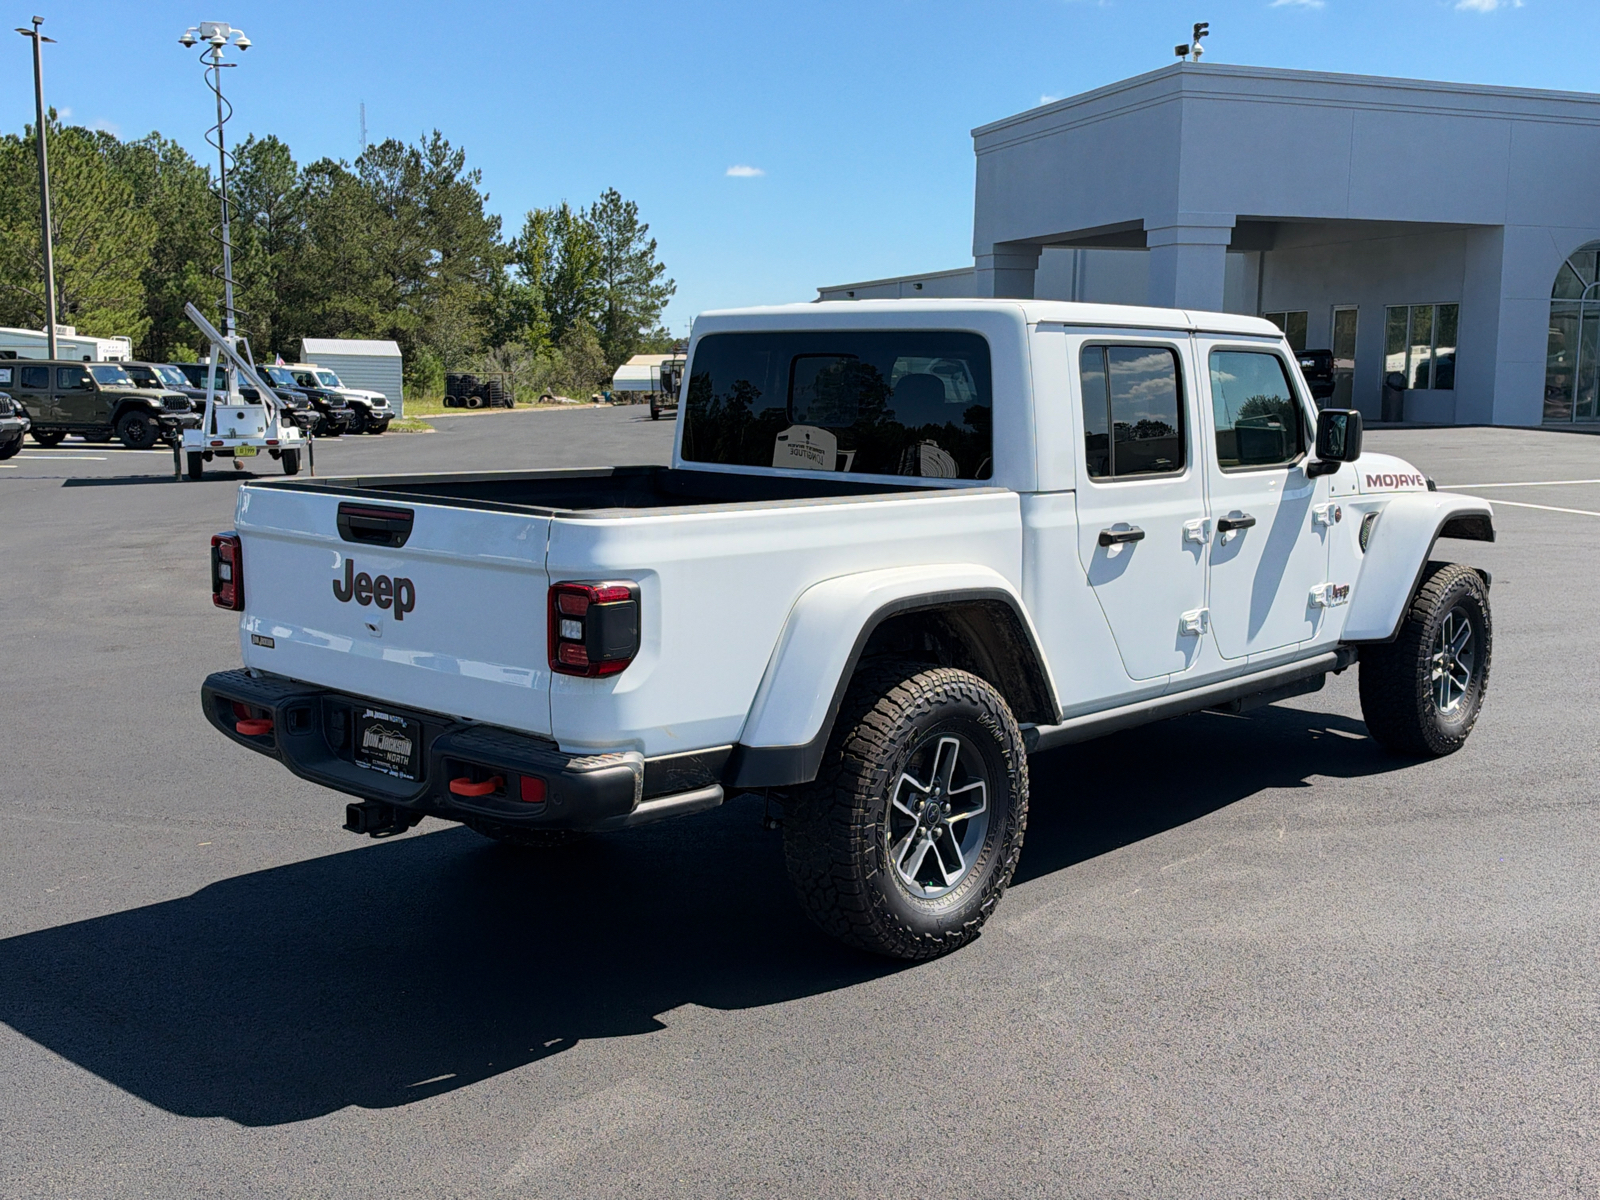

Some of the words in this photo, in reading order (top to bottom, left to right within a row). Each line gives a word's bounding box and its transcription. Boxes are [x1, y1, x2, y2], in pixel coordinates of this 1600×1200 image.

[1365, 474, 1425, 489] MOJAVE
[332, 558, 416, 622] Jeep
[363, 731, 379, 747] DON
[379, 735, 412, 756] JACKSON
[387, 752, 409, 765] NORTH
